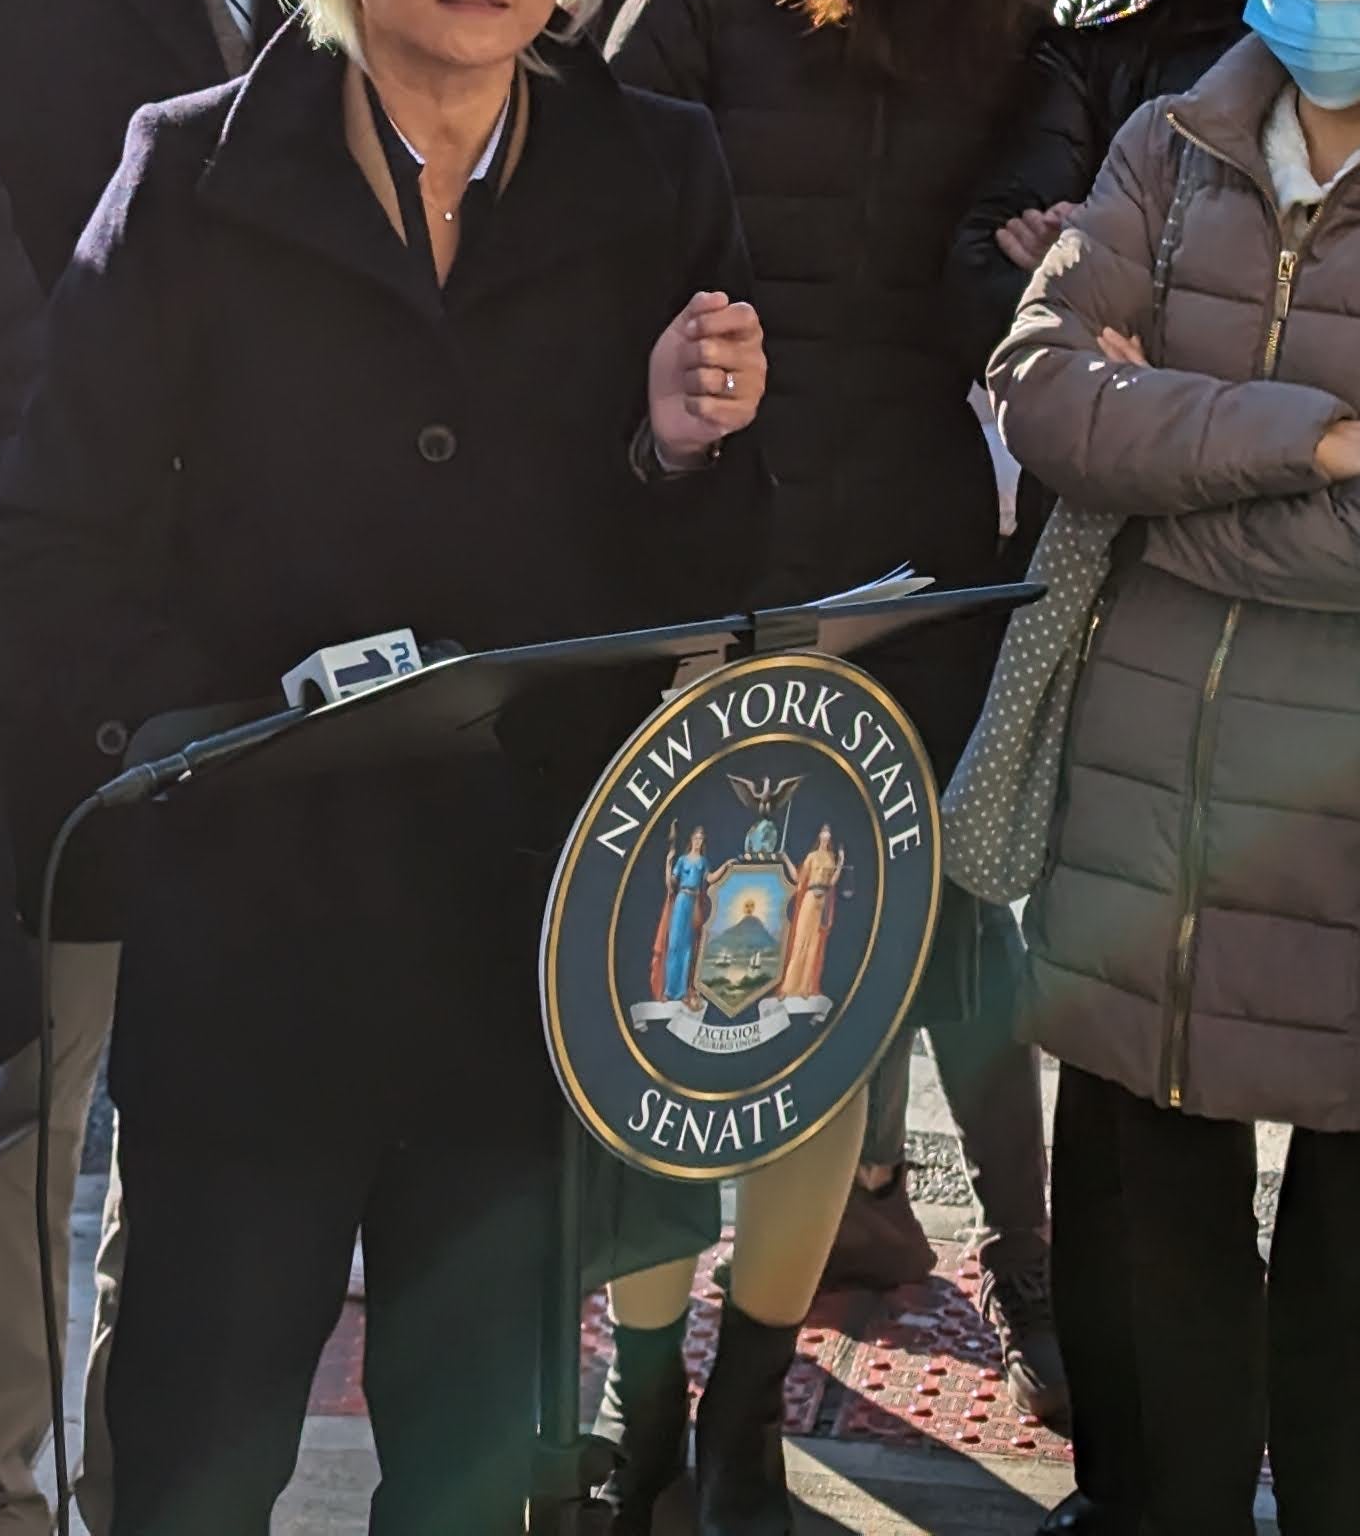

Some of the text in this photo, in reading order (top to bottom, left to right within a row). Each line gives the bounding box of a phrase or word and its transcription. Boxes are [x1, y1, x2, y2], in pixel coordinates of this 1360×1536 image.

[334, 648, 392, 698] 1
[595, 679, 923, 861] NEW YORK STATE
[696, 1024, 761, 1041] EXCELSIOR
[627, 1083, 799, 1155] SENATE
